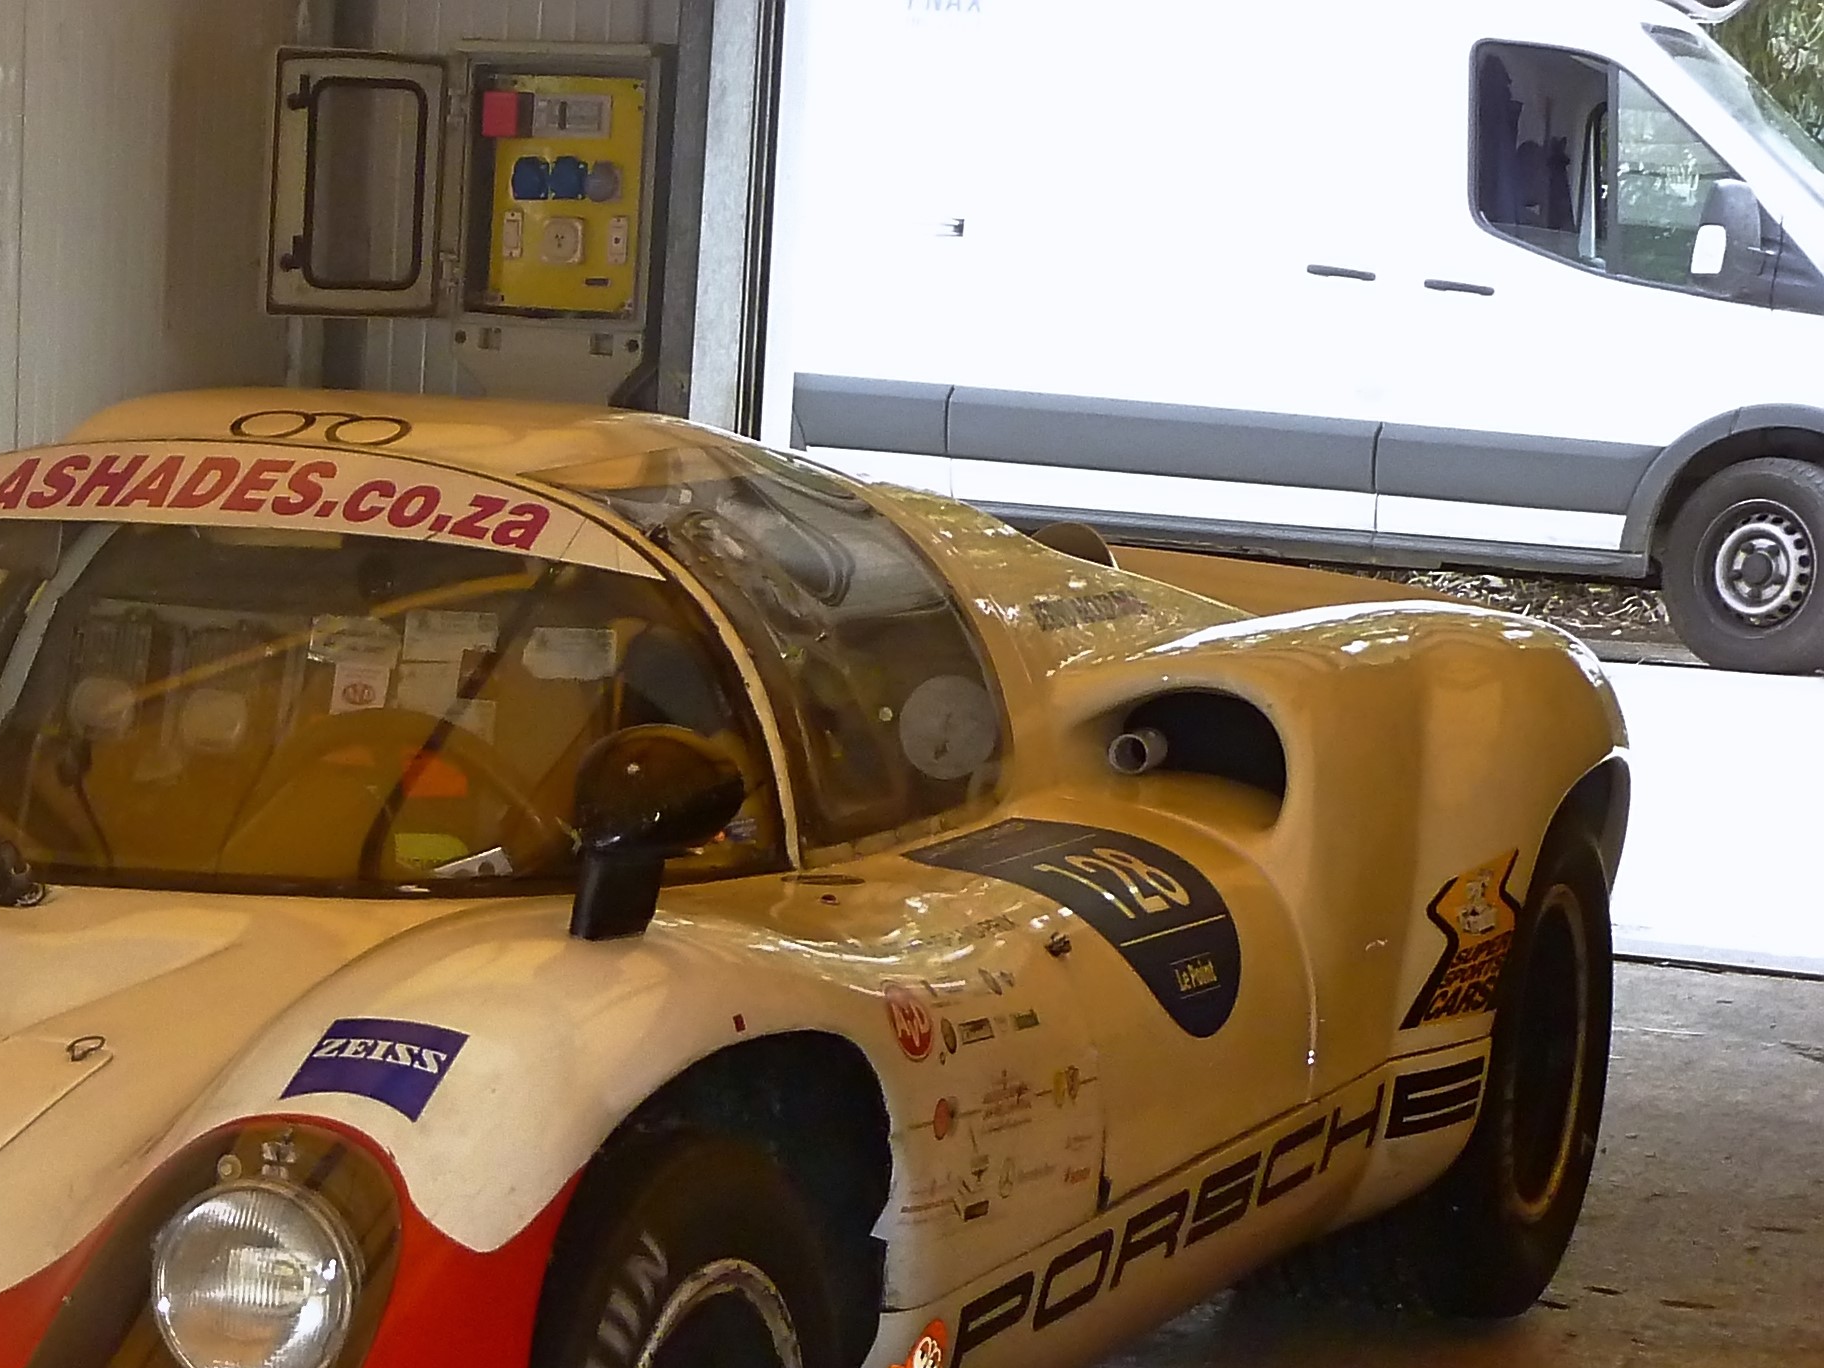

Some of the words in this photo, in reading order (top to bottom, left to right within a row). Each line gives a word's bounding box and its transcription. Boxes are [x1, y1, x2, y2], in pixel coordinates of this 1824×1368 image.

[1033, 847, 1190, 919] 128
[1423, 976, 1496, 1022] CARS
[312, 1038, 448, 1075] ZEISS
